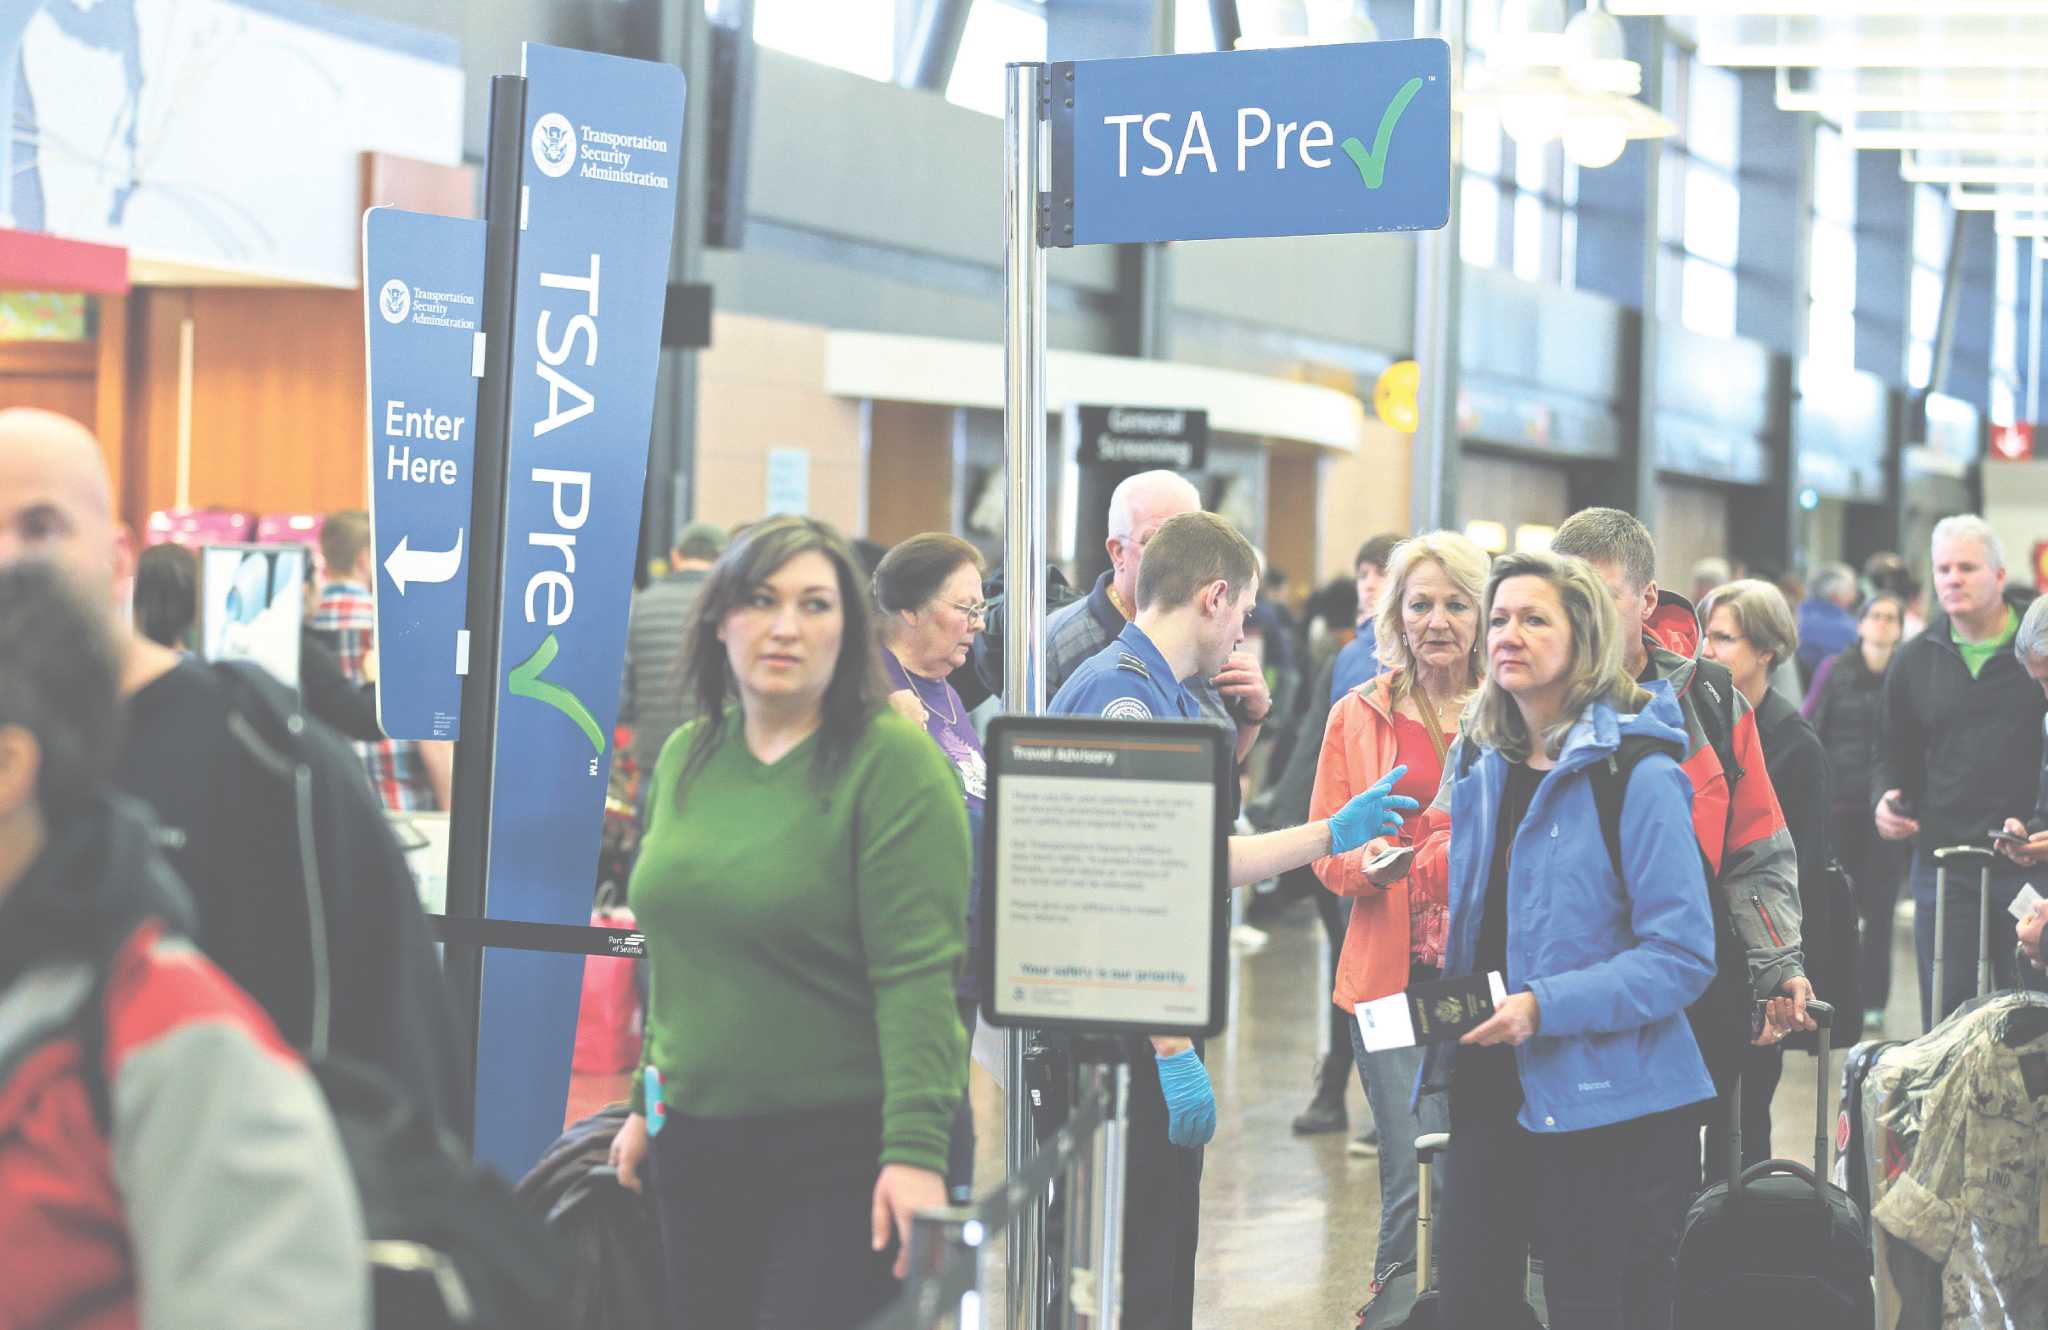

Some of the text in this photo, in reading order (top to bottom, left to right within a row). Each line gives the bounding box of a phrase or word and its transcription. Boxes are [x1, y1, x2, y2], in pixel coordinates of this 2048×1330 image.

[580, 125, 667, 153] Transportation
[1104, 107, 1333, 177] TSA Pre
[580, 145, 631, 170] Security
[579, 165, 669, 189] Administration
[412, 299, 448, 316] Security
[413, 287, 475, 305] Transportation
[411, 312, 475, 329] Administration
[385, 400, 465, 441] Enter
[1107, 407, 1185, 434] General
[523, 253, 600, 626] TSA Pre
[1097, 431, 1193, 465] Screening
[386, 445, 457, 485] Here
[588, 757, 598, 776] TM
[1012, 745, 1116, 767] Travel Advisory
[608, 935, 623, 945] Port
[619, 944, 643, 955] Seattle
[1020, 962, 1049, 976] Your
[1052, 962, 1093, 979] safety
